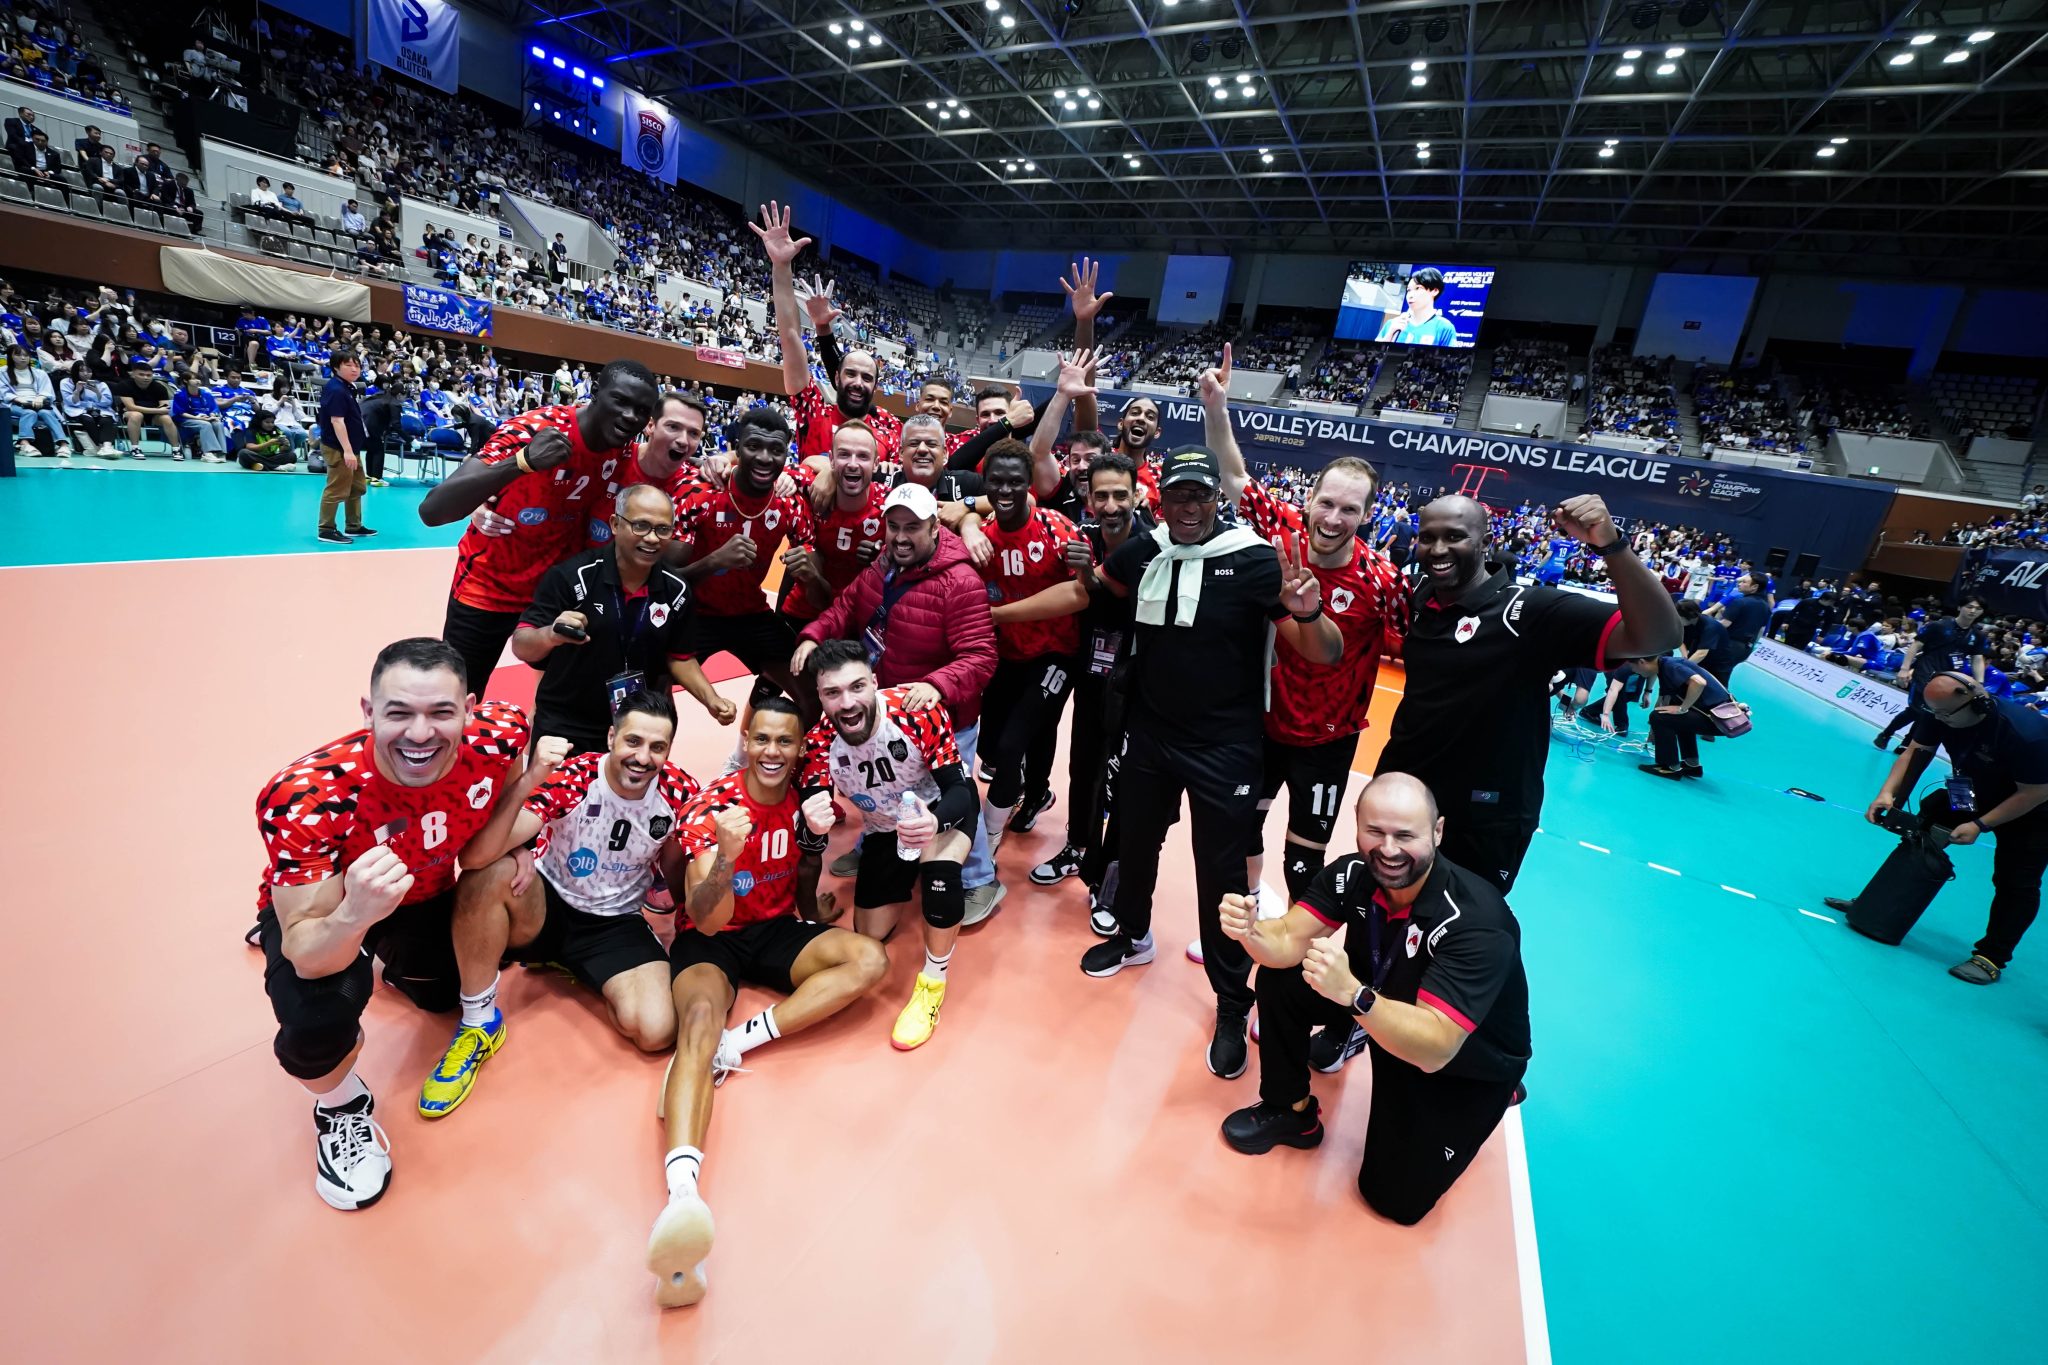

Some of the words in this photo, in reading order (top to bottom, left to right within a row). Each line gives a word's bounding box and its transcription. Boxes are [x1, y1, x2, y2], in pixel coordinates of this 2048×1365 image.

[396, 55, 432, 80] BLUTEON
[401, 46, 428, 67] OSAKA
[641, 117, 662, 131] SISCO
[218, 332, 235, 341] 123
[1238, 411, 1375, 445] VOLLEYBALL
[1388, 429, 1549, 468] CHAMPIONS
[1551, 449, 1671, 484] LEAGUE
[1281, 437, 1305, 447] 2025
[566, 475, 590, 500] 2
[1710, 488, 1741, 497] LEAGUE
[1713, 482, 1761, 494] CHAMPIONS
[836, 526, 854, 551] 5
[1000, 549, 1025, 576] 16
[1509, 600, 1525, 621] RAYYAN
[1040, 664, 1067, 694] 16
[857, 756, 896, 789] 20
[1311, 782, 1338, 817] 11
[420, 810, 447, 850] 8
[608, 818, 632, 851] 9
[761, 828, 789, 863] 10
[568, 856, 595, 872] QIB
[1430, 926, 1449, 948] RAYYAN
